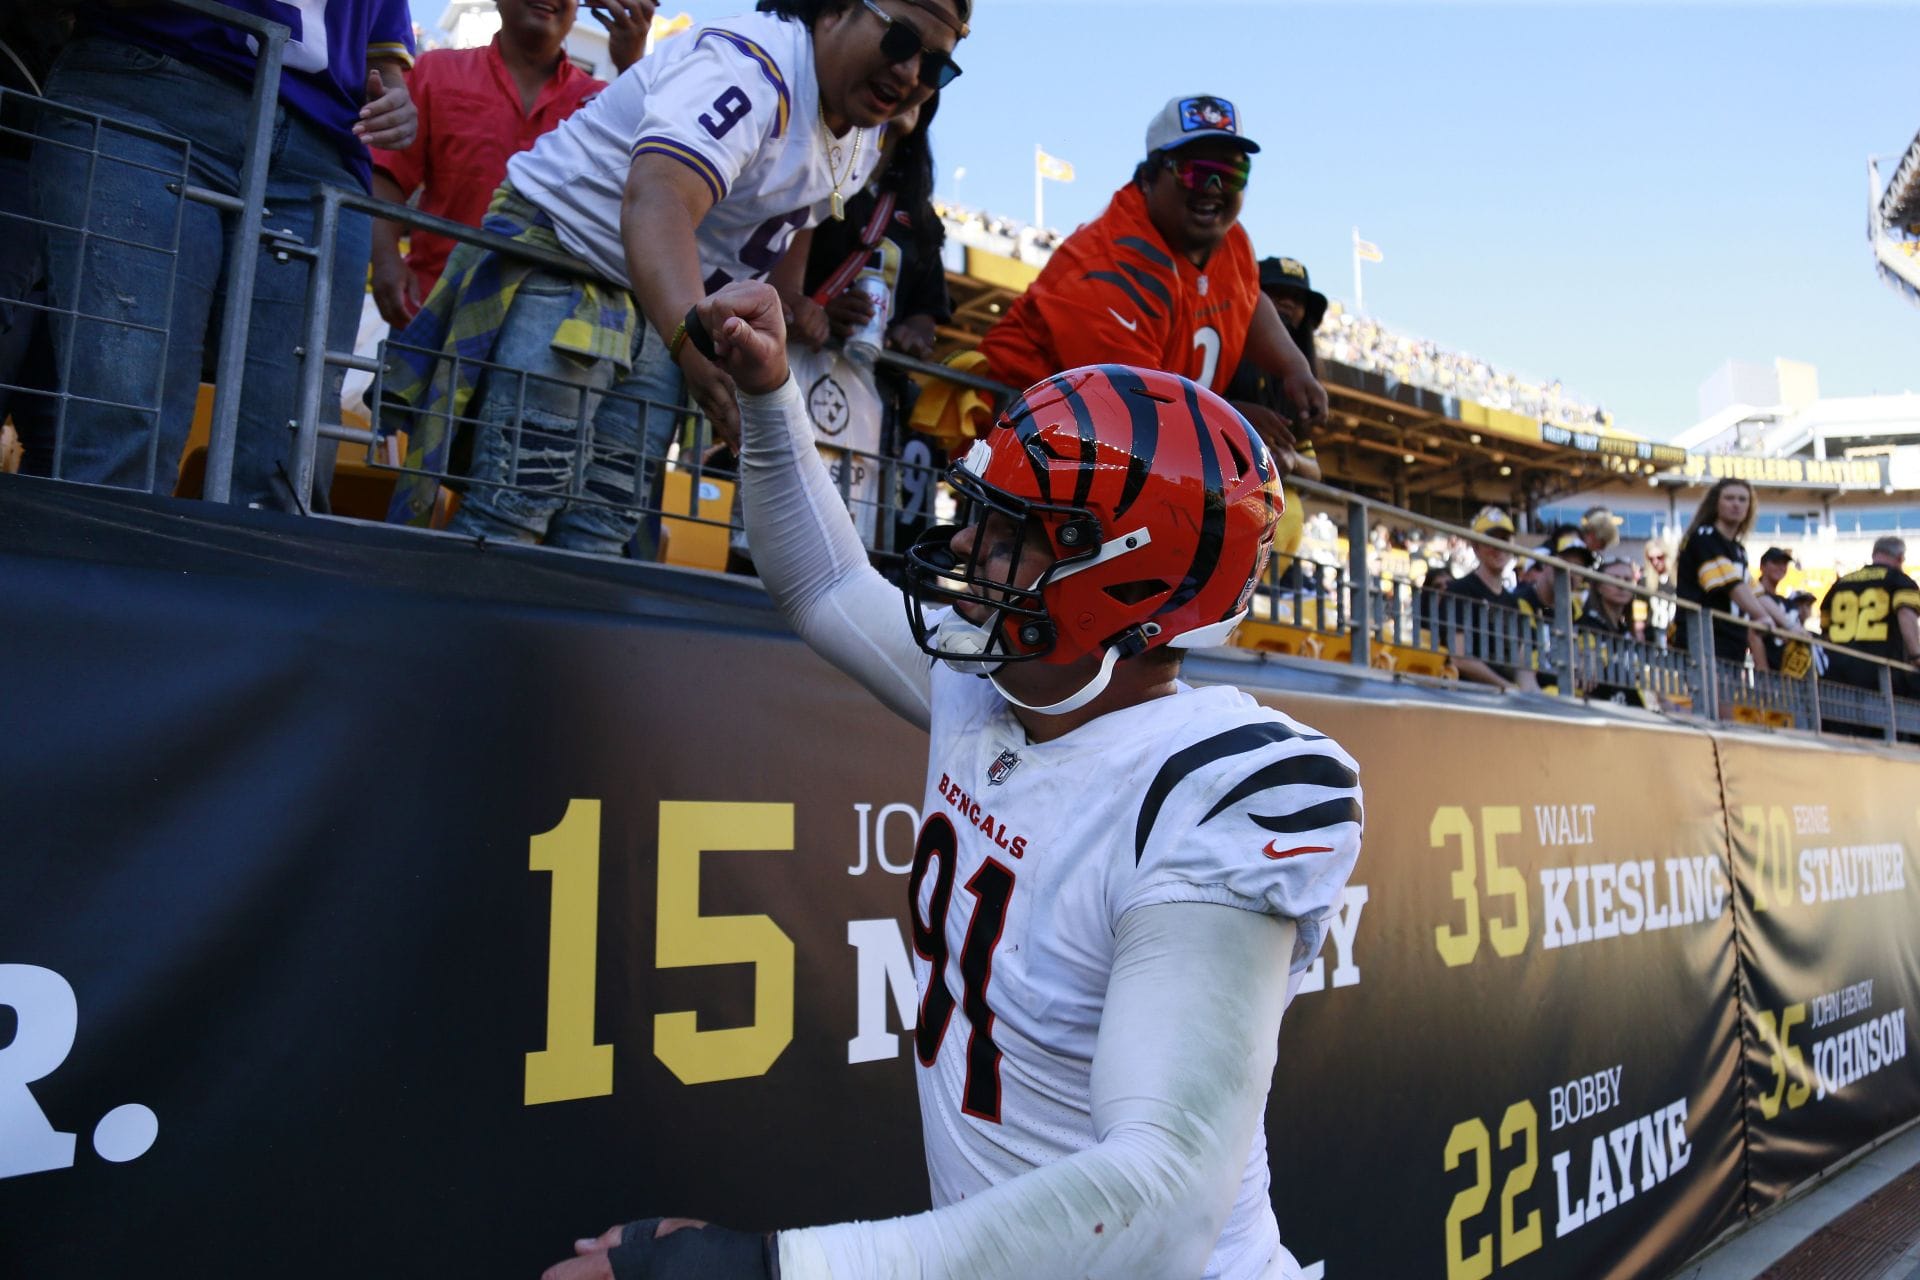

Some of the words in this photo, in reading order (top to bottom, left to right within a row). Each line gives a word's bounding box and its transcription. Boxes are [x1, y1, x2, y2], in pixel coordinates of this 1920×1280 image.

[698, 85, 752, 140] 9
[901, 440, 931, 525] 9
[1829, 587, 1890, 643] 92
[938, 772, 1028, 859] BENGALS
[1534, 804, 1595, 846] WALT
[1742, 805, 1794, 912] 70
[1430, 806, 1529, 967] 35
[1540, 853, 1724, 949] KIESLING
[1799, 843, 1906, 905] STAUTNER
[525, 798, 795, 1105] 15
[908, 811, 1016, 1125] 91
[1811, 990, 1840, 1029] JOHN
[1841, 979, 1873, 1017] HENRY
[1550, 1064, 1623, 1131] BOBBY
[1812, 1008, 1907, 1101] JOHNSON
[1444, 1099, 1543, 1280] 22
[1552, 1097, 1692, 1239] LAYNE
